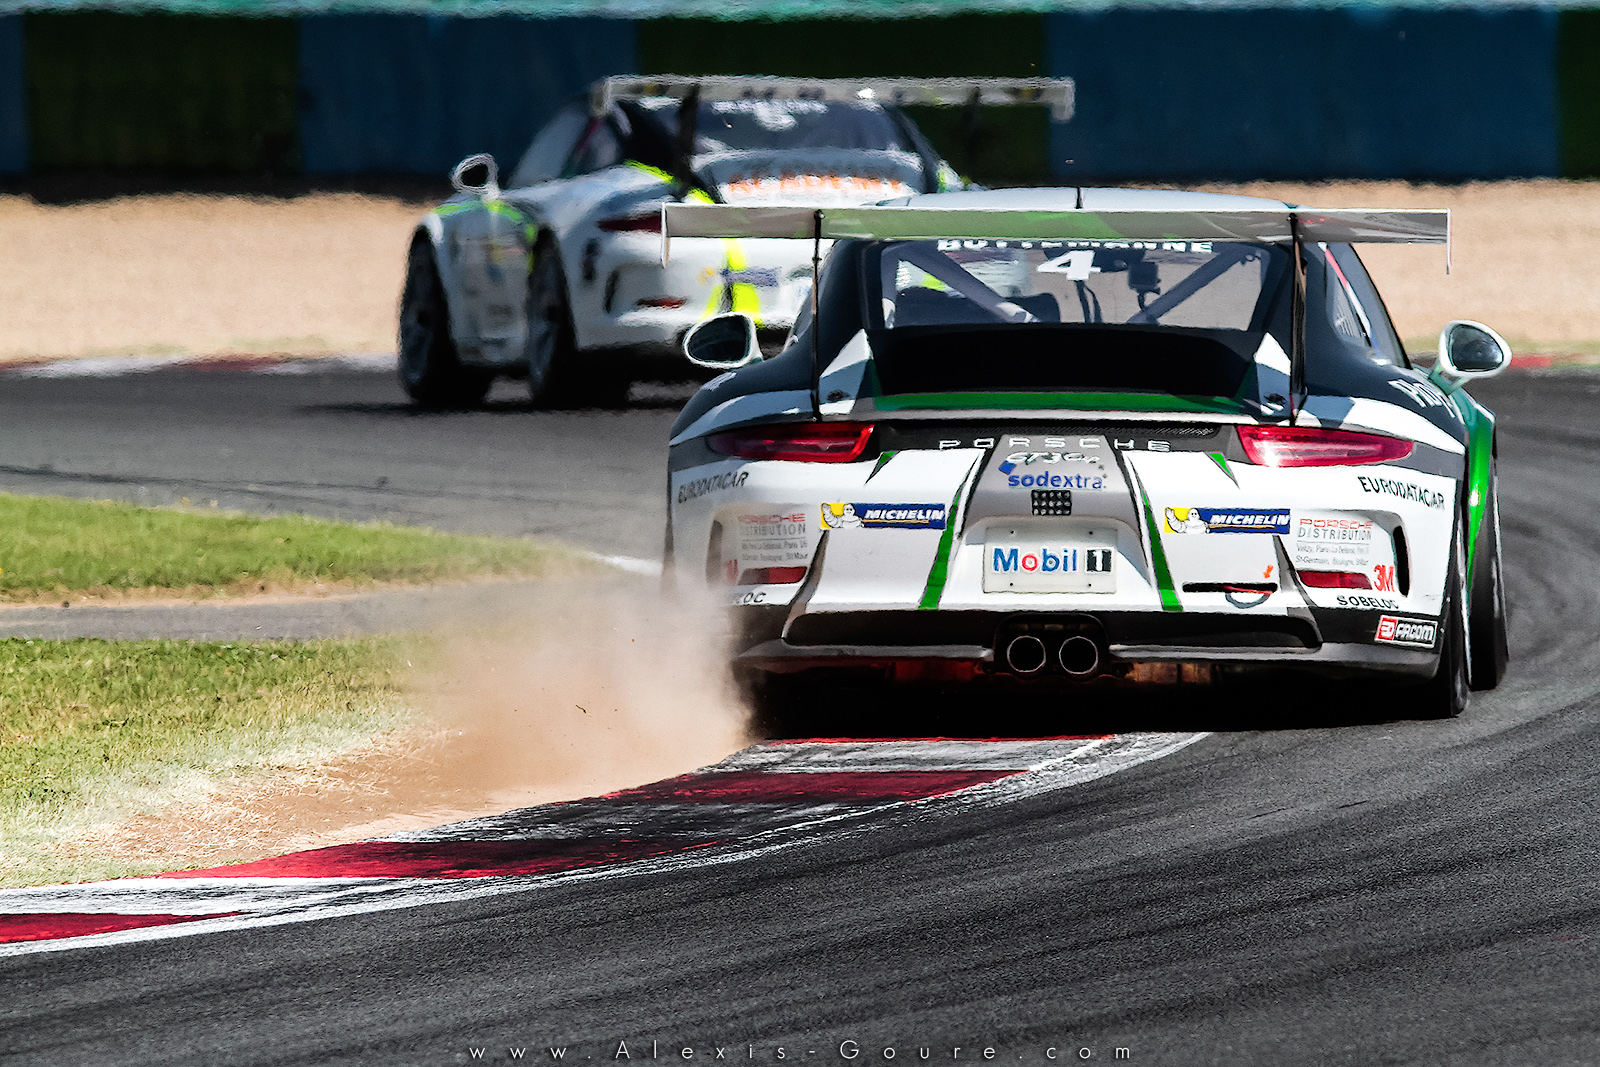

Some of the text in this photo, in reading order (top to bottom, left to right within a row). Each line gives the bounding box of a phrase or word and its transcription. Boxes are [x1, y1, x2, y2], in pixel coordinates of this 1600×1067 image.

[1037, 250, 1100, 280] 4
[938, 437, 1171, 451] PORSCHE
[1008, 471, 1103, 489] sodextra
[1357, 476, 1445, 510] EURODATACAR
[864, 508, 945, 521] MICHELIN
[1208, 512, 1290, 525] MICHELIN
[1299, 518, 1373, 530] PORSCHE
[1297, 527, 1372, 541] DISTRIBUTION
[992, 547, 1078, 573] Mobil
[1373, 565, 1396, 592] 3M
[1336, 595, 1399, 609] SOBELOC
[1396, 623, 1434, 641] FACOM
